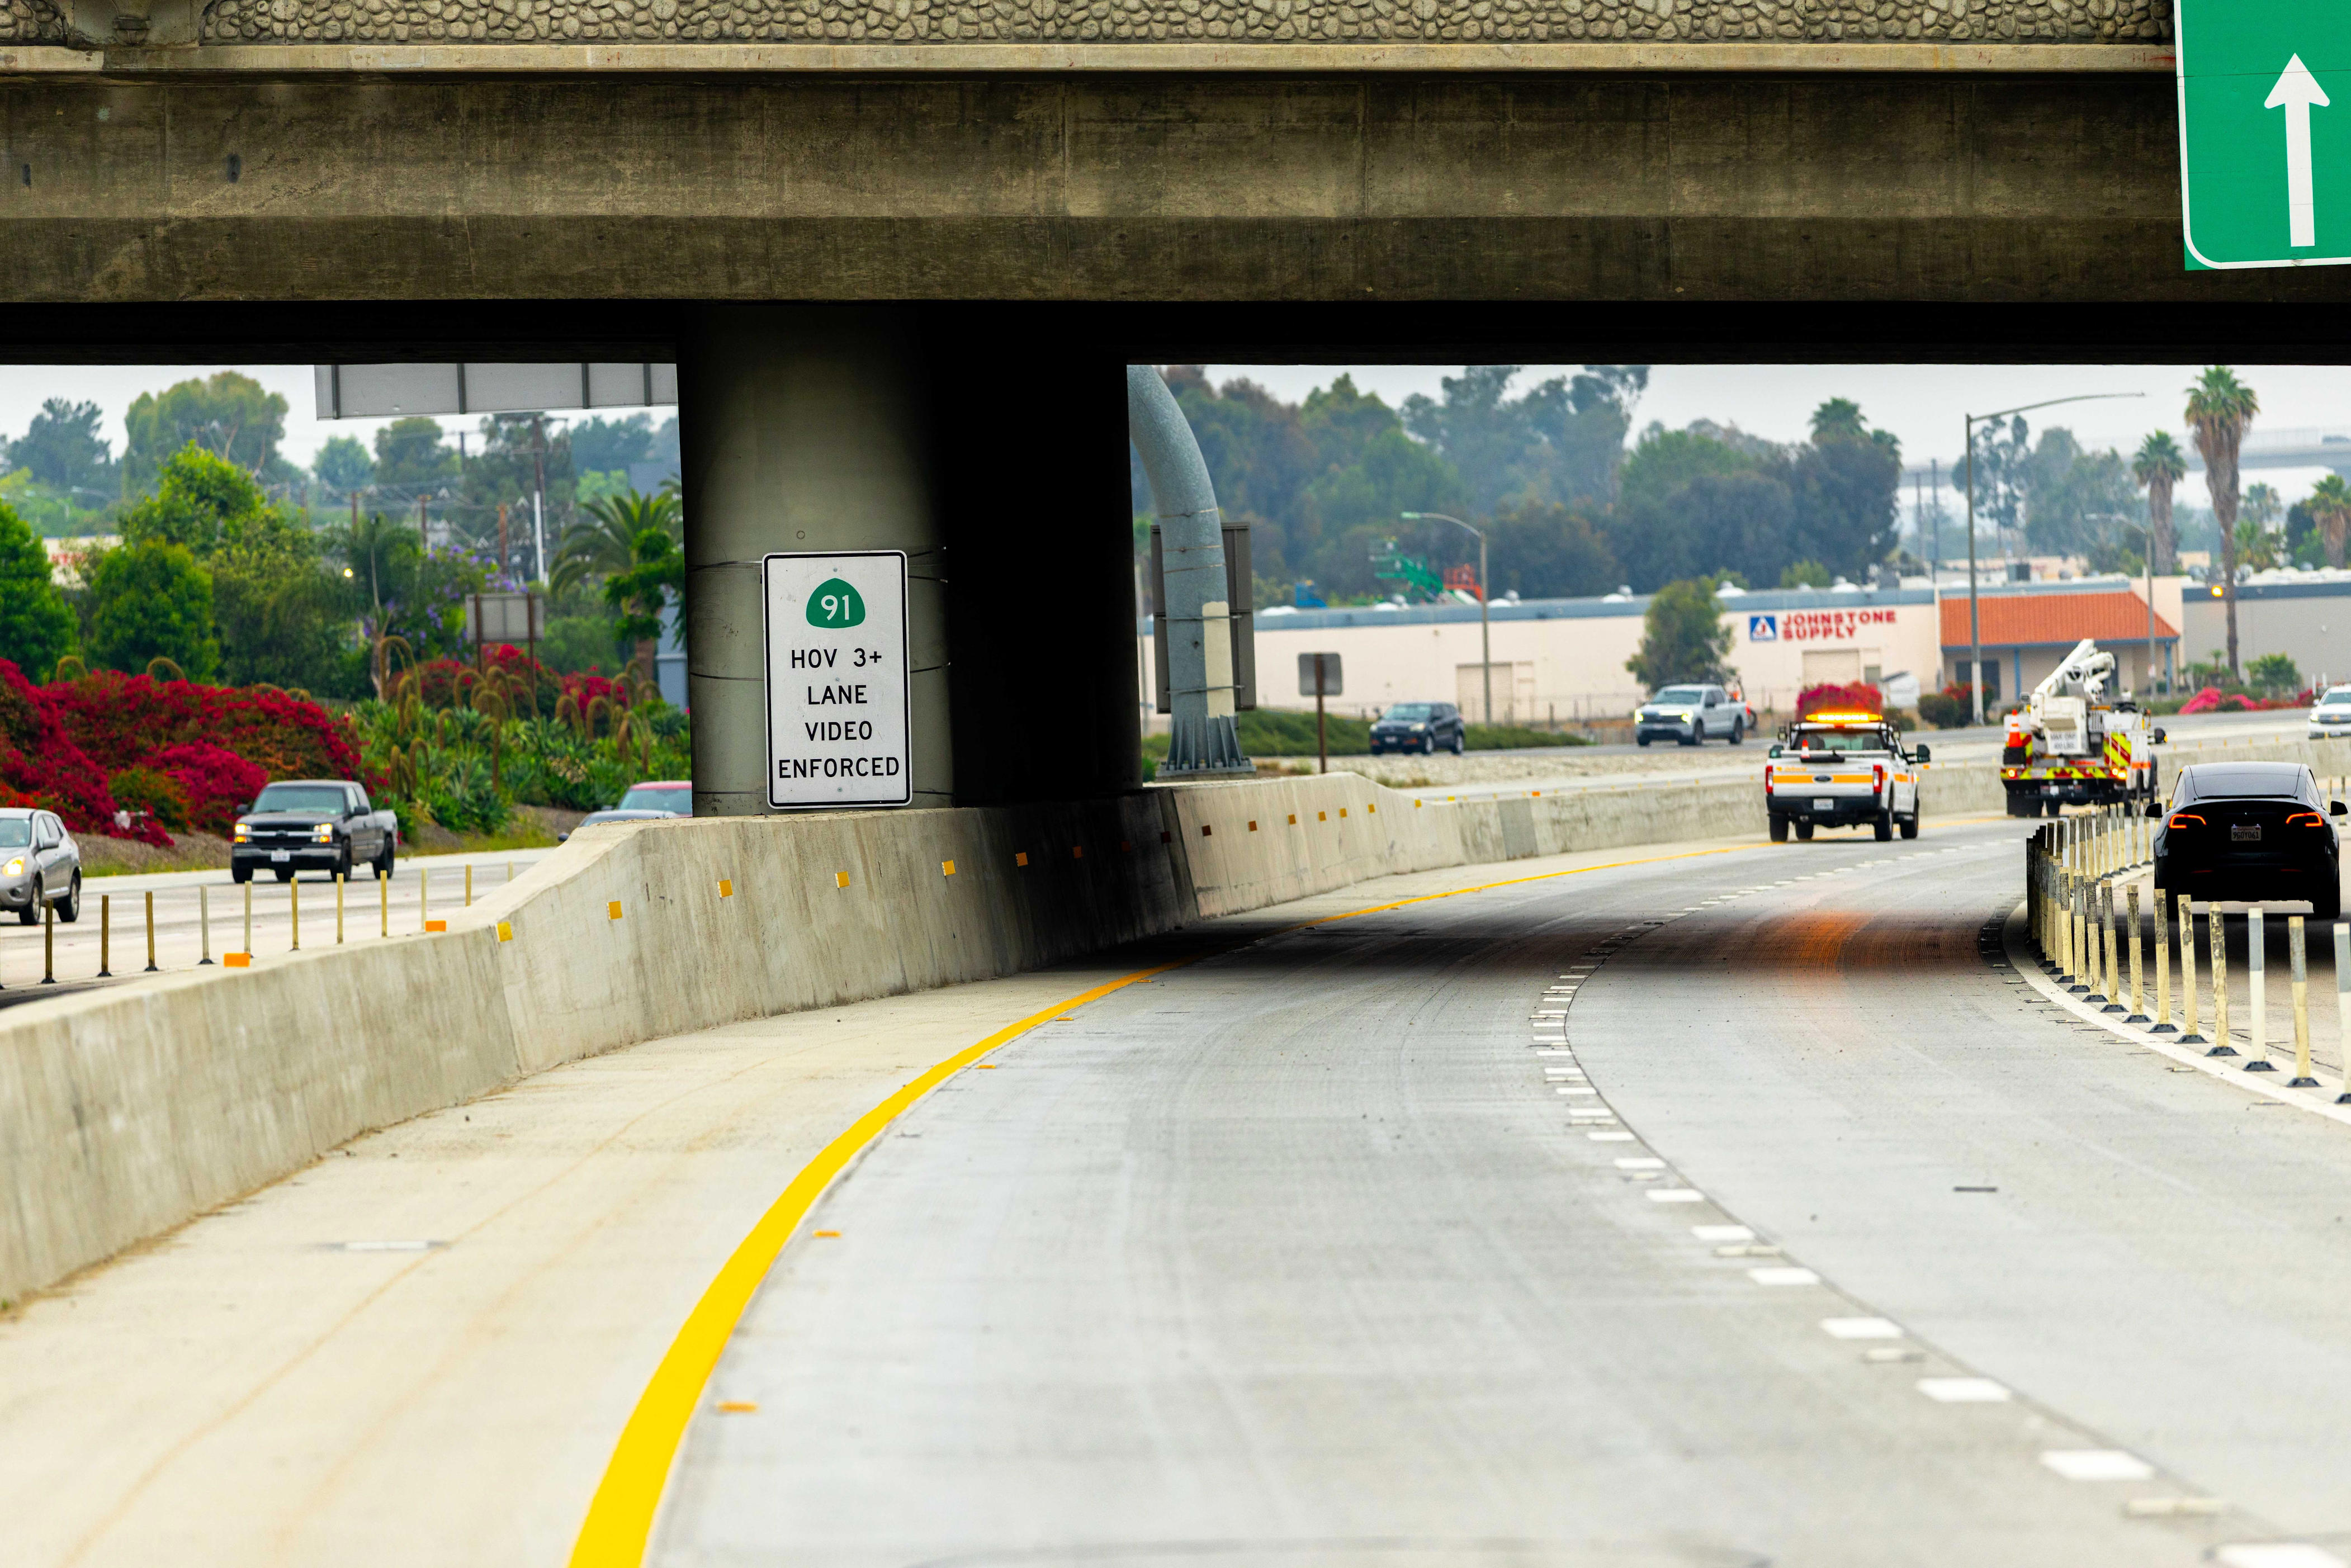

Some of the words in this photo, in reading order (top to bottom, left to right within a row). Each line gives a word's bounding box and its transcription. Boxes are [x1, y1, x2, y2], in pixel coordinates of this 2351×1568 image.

[821, 595, 849, 620] 91
[1782, 610, 1896, 626] JOHNSTONE
[1782, 626, 1856, 641] SUPPLY
[791, 648, 838, 669] HOV
[853, 647, 882, 667] 3+
[808, 684, 868, 705] LANE
[805, 721, 873, 741] VIDEO
[779, 757, 899, 779] ENFORCED
